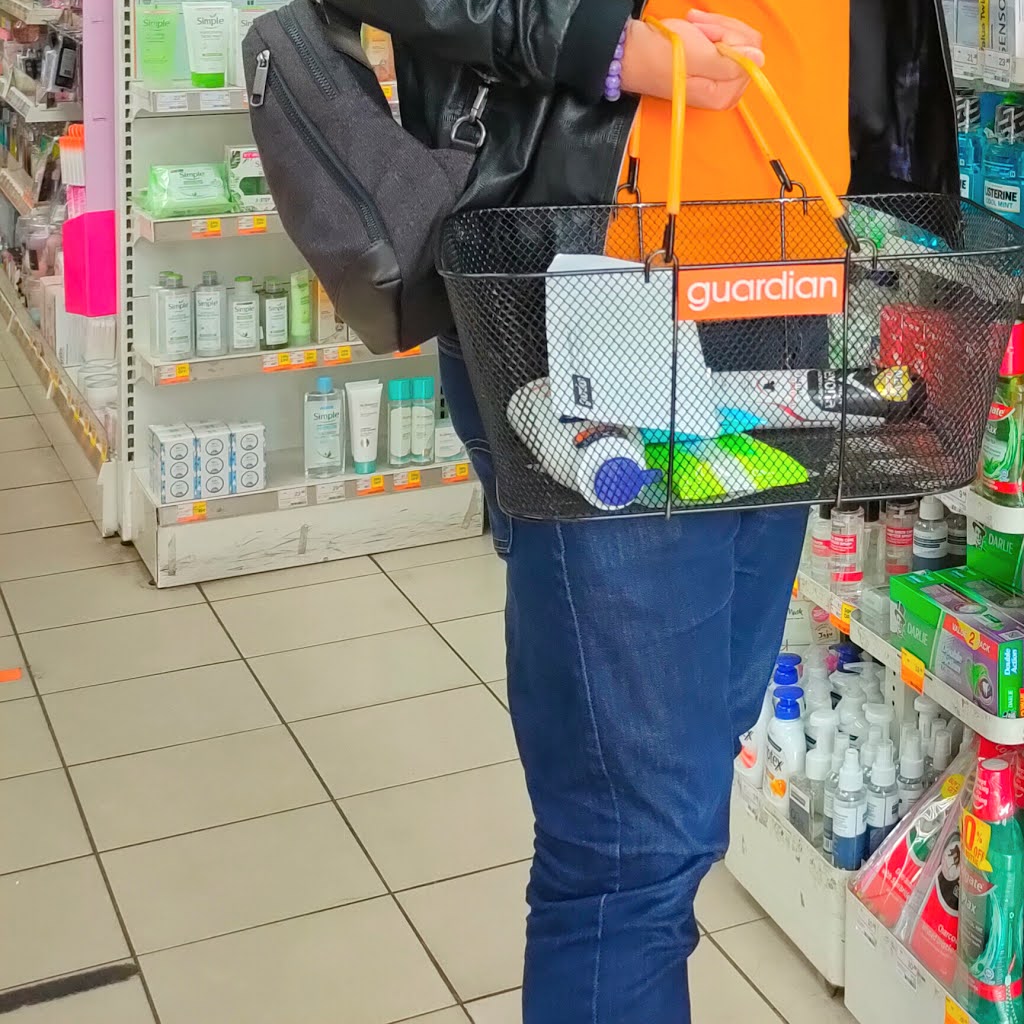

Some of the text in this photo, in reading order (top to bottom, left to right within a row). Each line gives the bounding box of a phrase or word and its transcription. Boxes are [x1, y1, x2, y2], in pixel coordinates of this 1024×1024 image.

[197, 17, 224, 26] Simple
[686, 270, 839, 312] guardian
[168, 302, 188, 311] Simple
[234, 305, 254, 313] Simple
[313, 411, 339, 421] Simple
[988, 534, 1014, 555] DARLIE
[907, 623, 928, 646] DARLIE
[968, 631, 976, 646] 2
[974, 848, 985, 862] OFF
